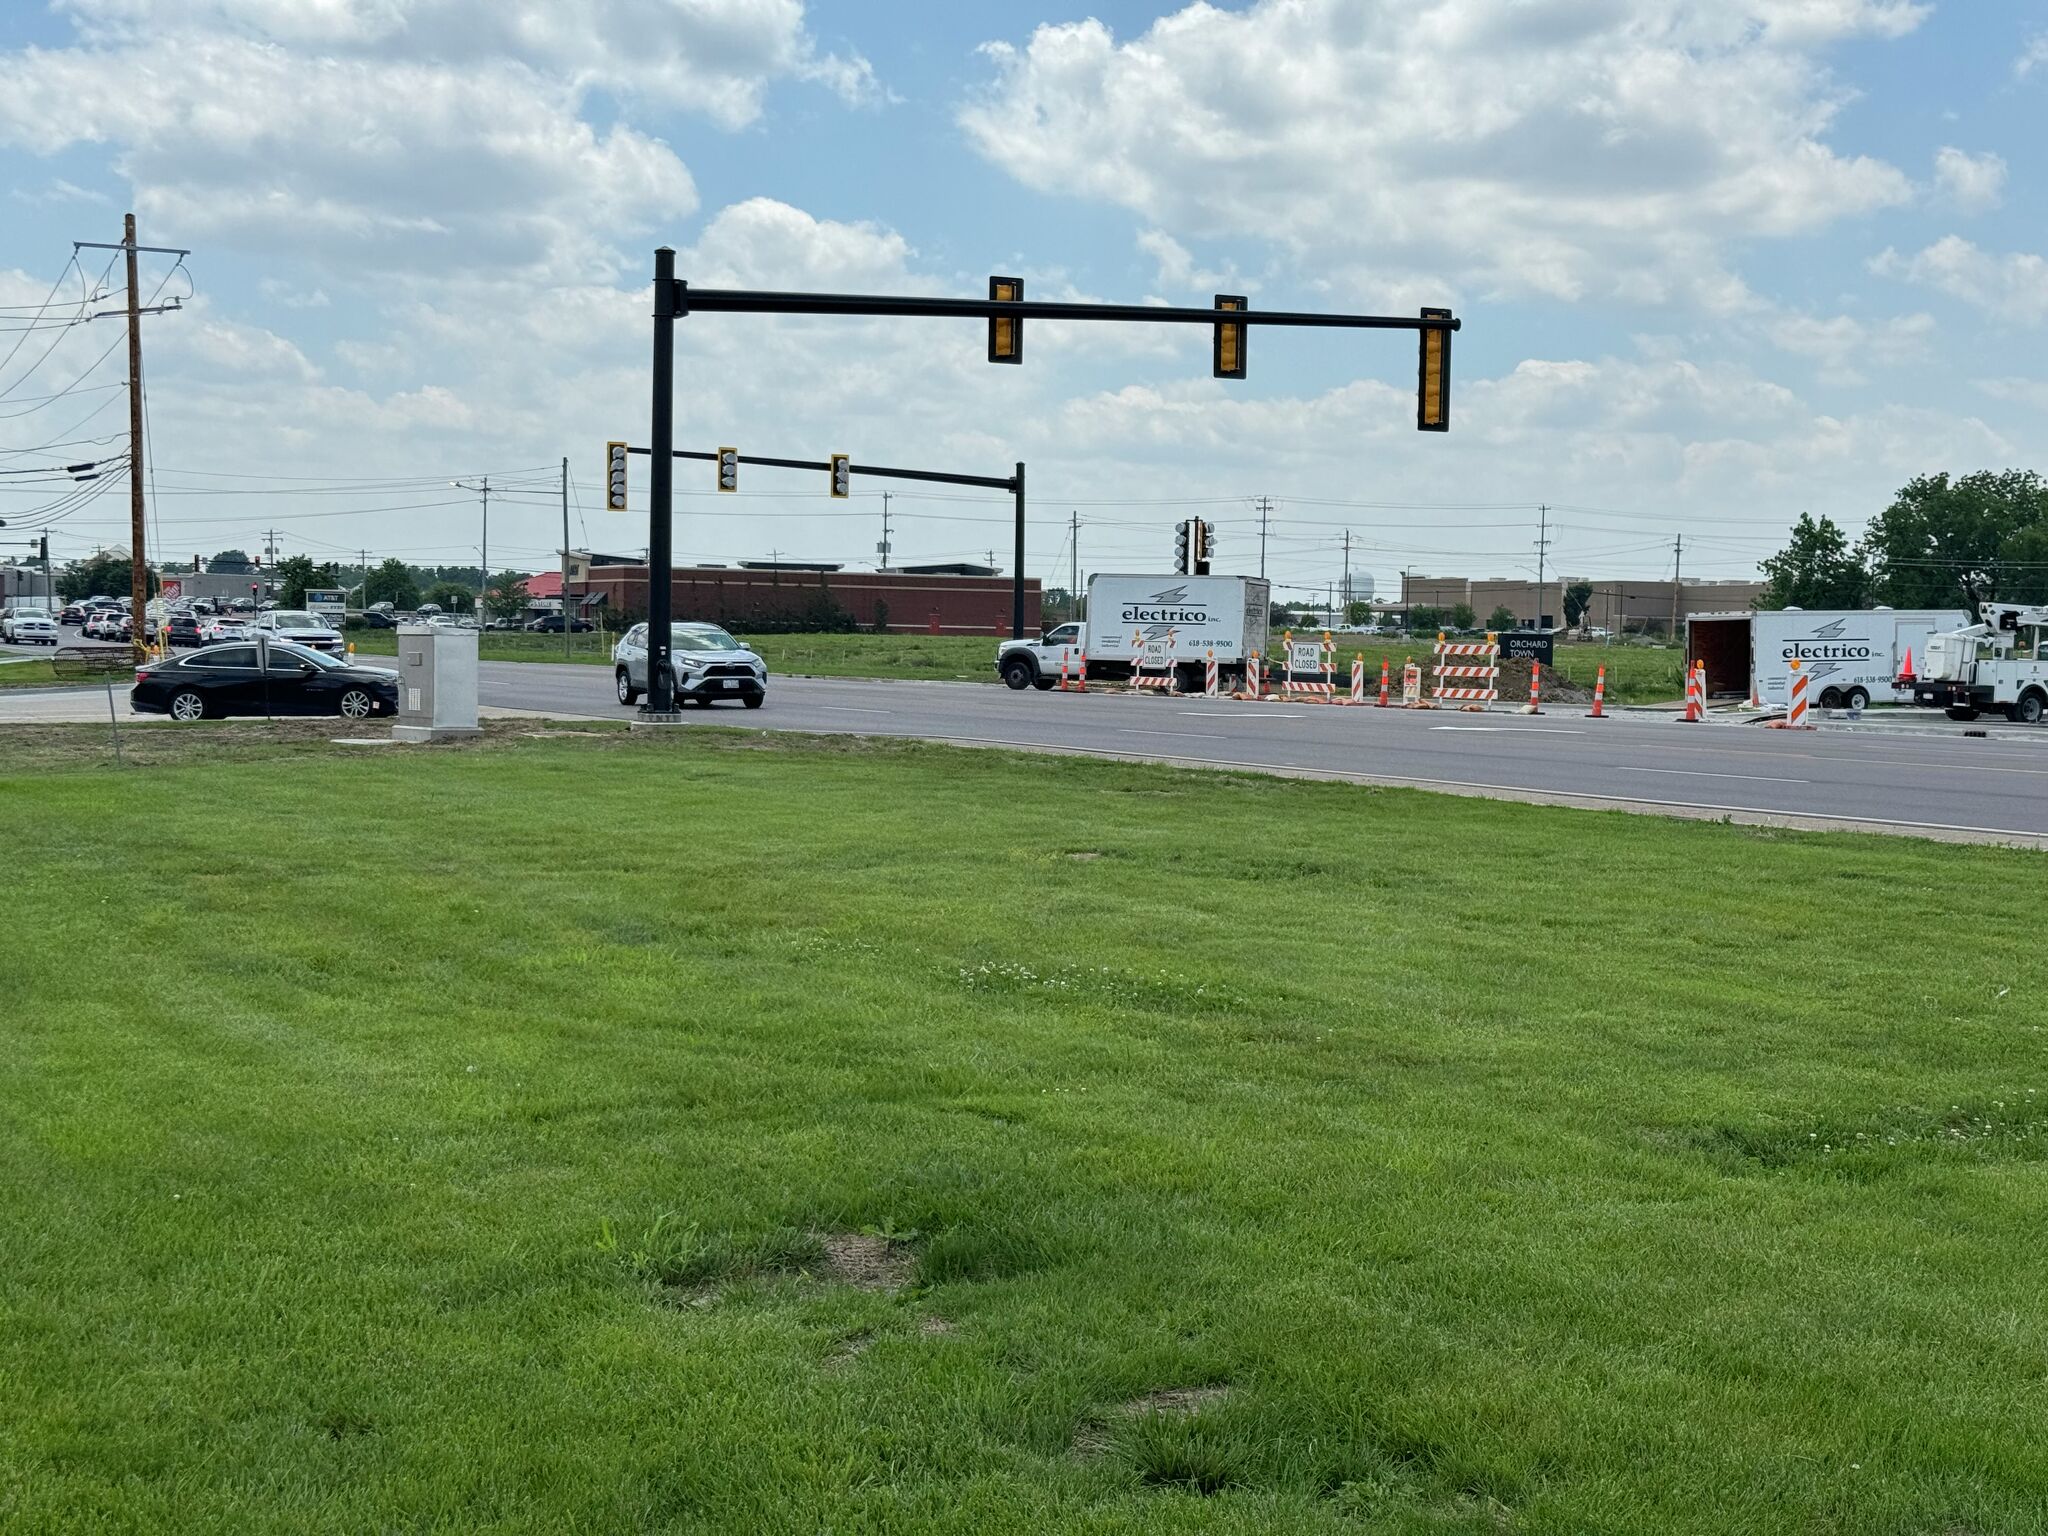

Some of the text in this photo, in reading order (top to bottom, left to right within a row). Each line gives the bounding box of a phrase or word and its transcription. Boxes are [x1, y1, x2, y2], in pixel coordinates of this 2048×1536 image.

[1122, 606, 1207, 622] electrico
[1189, 640, 1233, 648] 618-538-9500
[1510, 640, 1548, 648] ORCHARD
[1148, 645, 1162, 654] ROAD
[1298, 648, 1314, 657] ROAD
[1782, 643, 1870, 658] electrico
[1145, 656, 1164, 664] CLOSED
[1295, 660, 1317, 669] CLOSED
